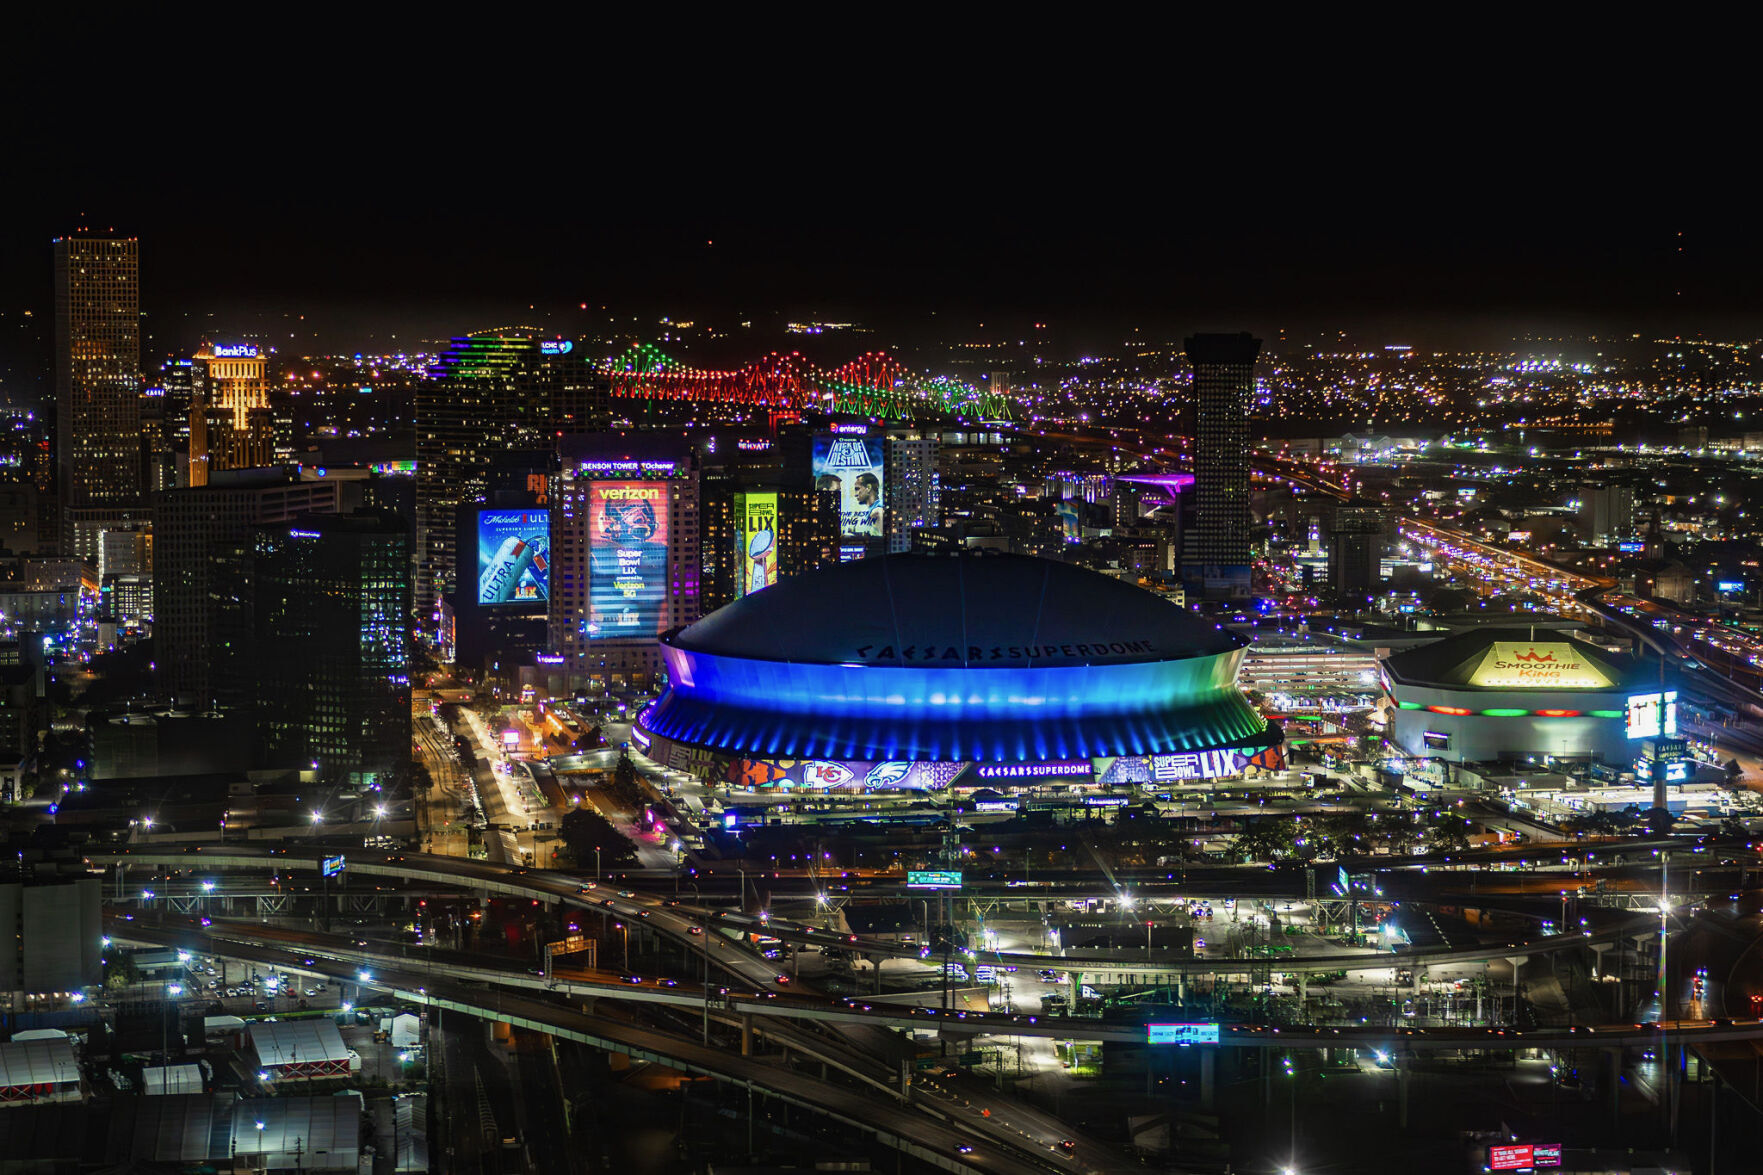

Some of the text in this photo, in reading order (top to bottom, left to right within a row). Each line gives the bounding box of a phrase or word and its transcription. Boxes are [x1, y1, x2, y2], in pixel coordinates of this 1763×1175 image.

[215, 345, 257, 357] BankPlus
[839, 425, 867, 434] entergy
[828, 451, 867, 466] DESTINY
[645, 462, 674, 470] Ochsner
[599, 485, 660, 500] verizon
[483, 514, 521, 525] Michelob
[748, 516, 775, 532] LIX
[616, 549, 643, 558] Super
[618, 558, 641, 566] Bowl
[482, 560, 515, 600] ULTRA
[613, 581, 645, 590] Verizon
[856, 639, 1157, 661] CAESARS SUPERDOME
[1494, 661, 1581, 669] SMOOTHIE
[1153, 748, 1238, 779] SUPER LIX
[979, 764, 1091, 776] CAESARS SUPERDOME
[1154, 766, 1201, 779] BOWL
